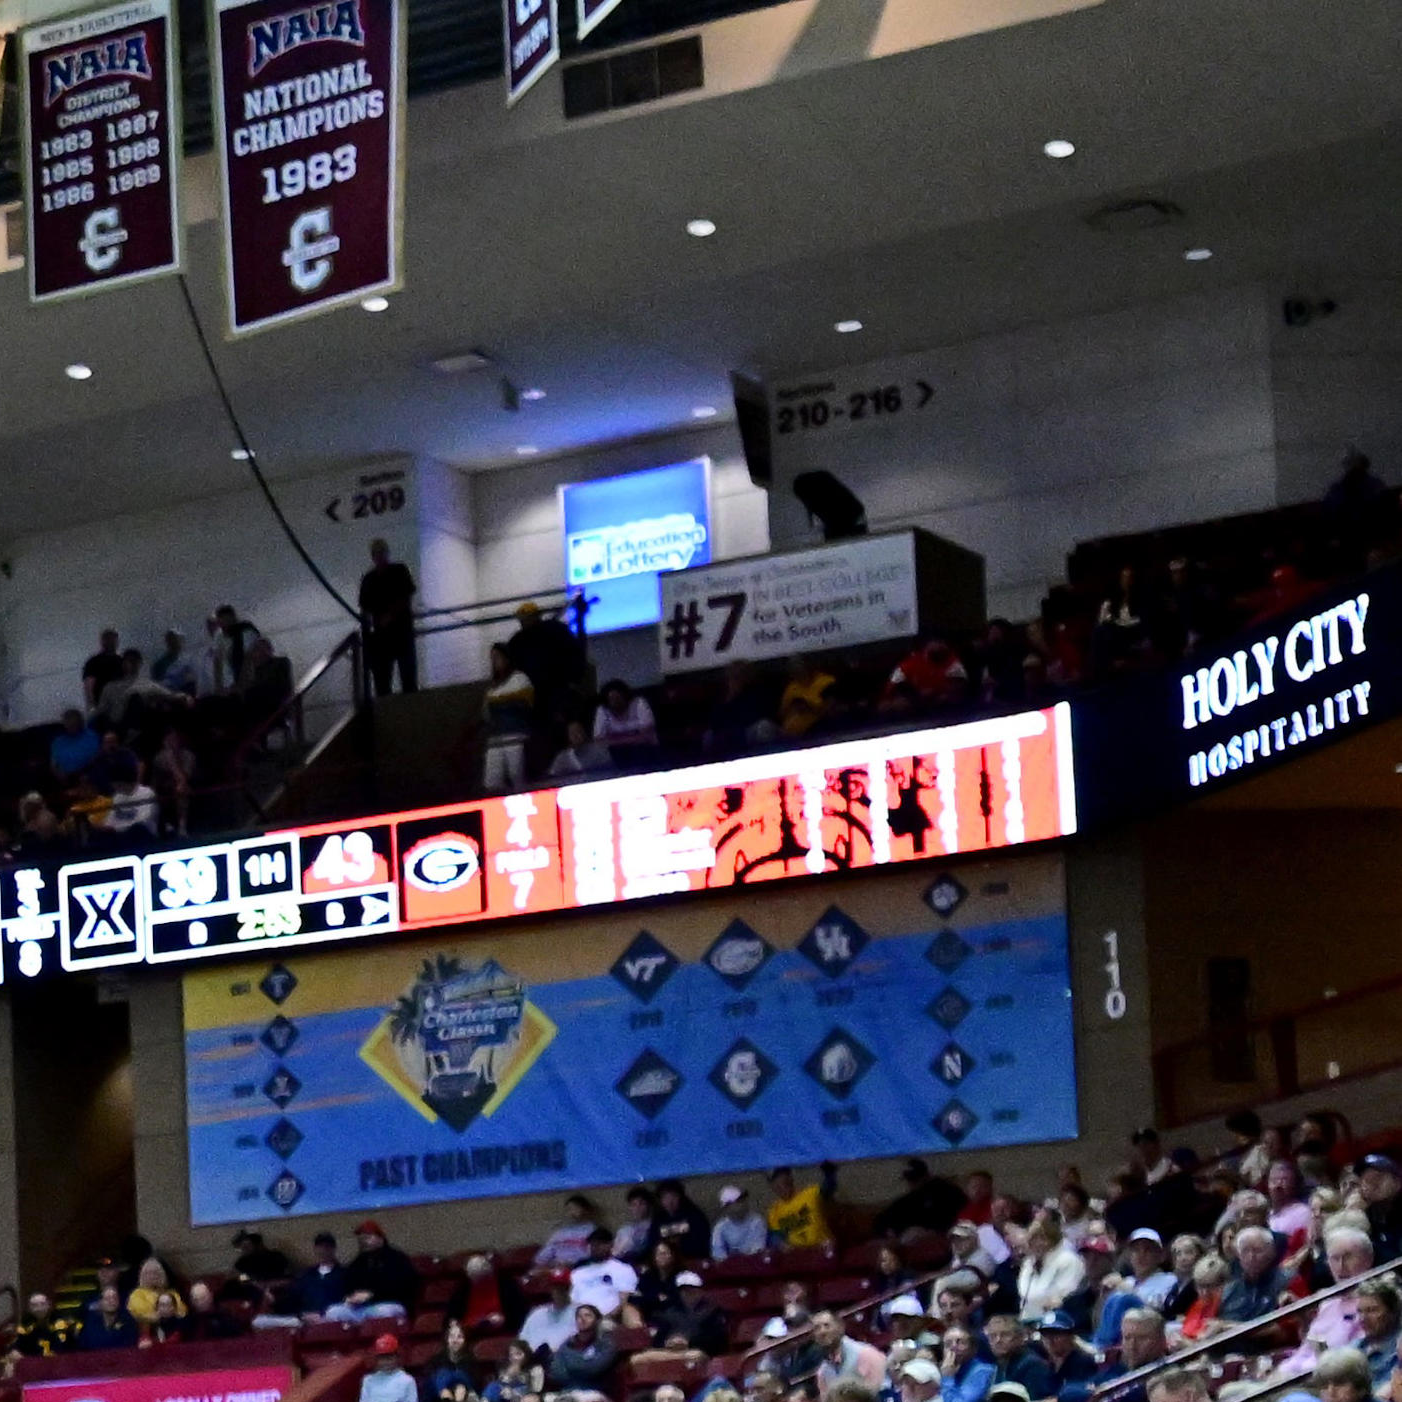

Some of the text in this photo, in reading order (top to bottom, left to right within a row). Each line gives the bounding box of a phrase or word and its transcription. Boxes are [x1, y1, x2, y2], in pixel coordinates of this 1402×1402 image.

[248, 0, 364, 76] NAIA
[43, 31, 152, 108] NAIA
[244, 59, 372, 120] NATIONAL
[57, 95, 140, 128] CHAMPIONS
[65, 81, 131, 111] DISTRICT
[234, 90, 384, 157] CHAMPIONS
[261, 144, 357, 203] 1983
[352, 486, 406, 519] 209
[607, 528, 702, 554] Education
[607, 549, 686, 574] Lottery
[665, 592, 747, 660] #7
[753, 591, 885, 623] for Veterans in
[753, 618, 842, 644] the South
[1181, 593, 1370, 730] HOLY CITY
[1188, 680, 1371, 787] HOSPITALITY
[507, 817, 532, 846] 4
[244, 851, 286, 887] 1H
[315, 831, 375, 885] 43
[513, 871, 534, 909] 7
[1103, 930, 1127, 1020] 110
[424, 1005, 519, 1028] Charleston
[360, 1140, 568, 1191] PAST CHAMPIONS
